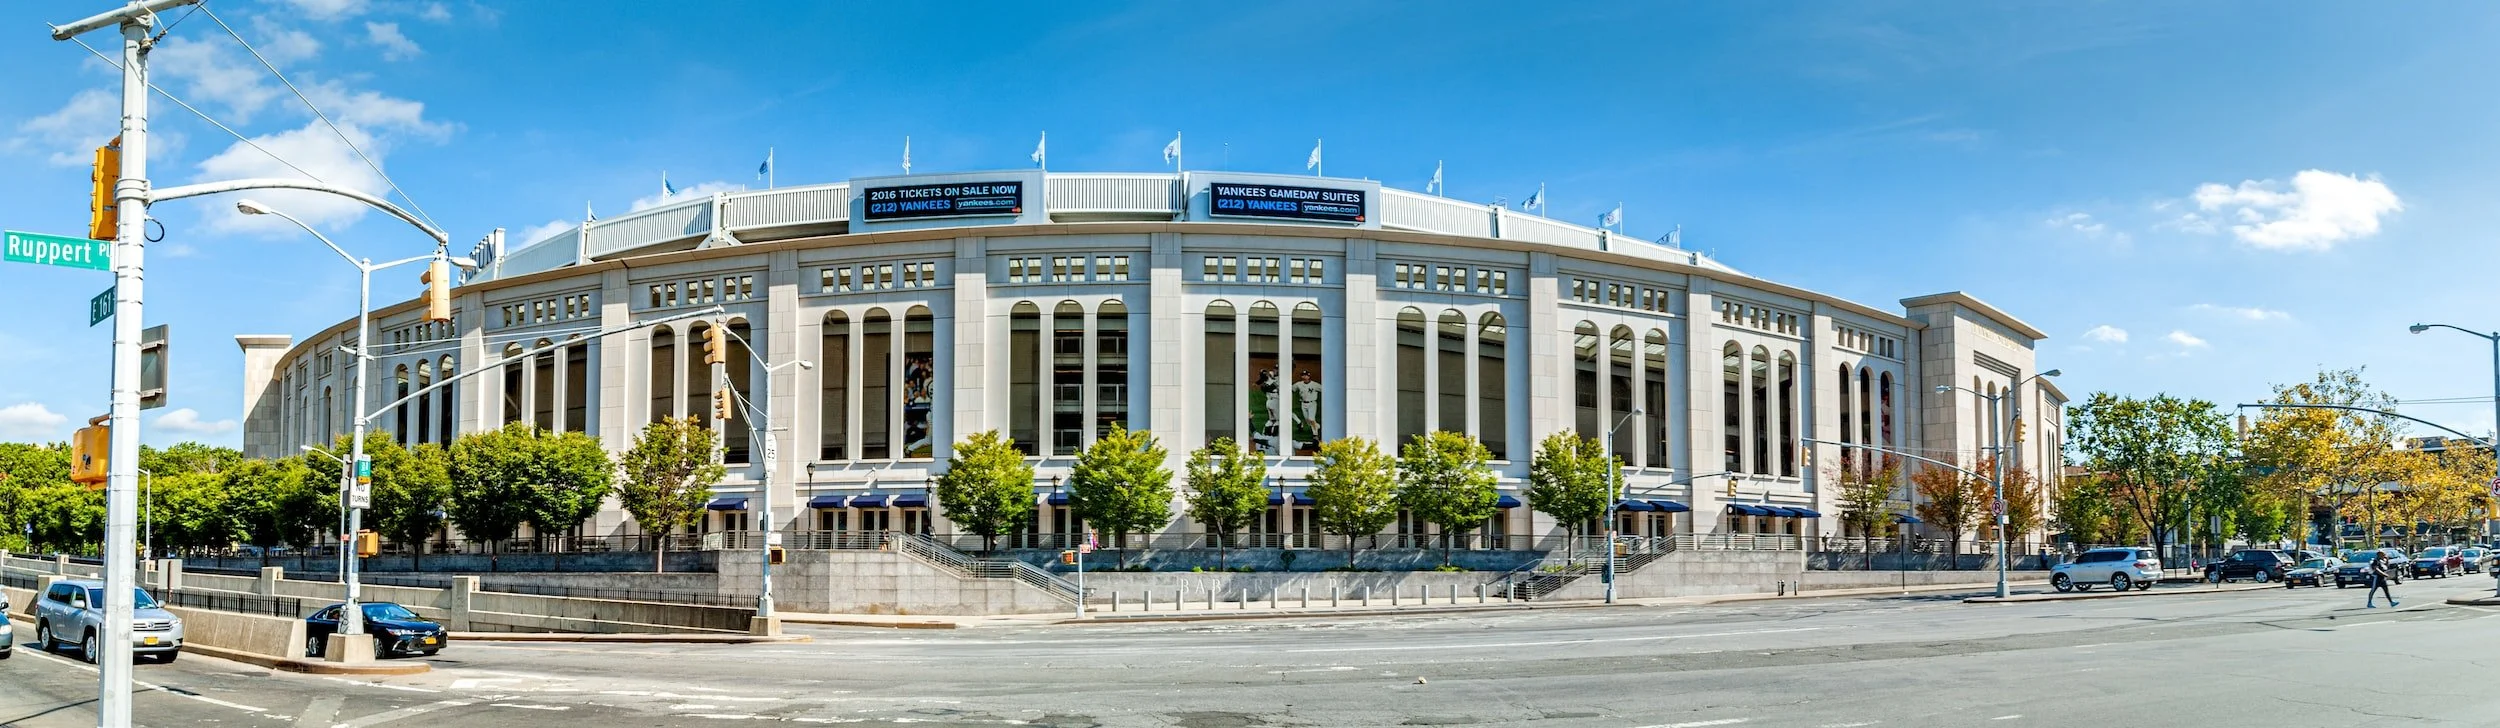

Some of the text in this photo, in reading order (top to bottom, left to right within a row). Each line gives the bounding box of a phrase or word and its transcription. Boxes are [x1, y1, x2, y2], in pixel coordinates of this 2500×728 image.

[871, 185, 1016, 200] 2016 TICKETS ON SALE NOW
[1217, 186, 1360, 203] YANKEES GAMEDAY SUITES
[871, 199, 951, 213] (212) YANKEES
[957, 200, 1014, 208] yankees.com
[1217, 199, 1297, 212] (212) YANKEES
[1303, 204, 1358, 214] yankees.com
[9, 235, 91, 264] Ruppert
[92, 301, 97, 322] E
[99, 292, 111, 318] 161
[352, 495, 368, 503] TURNS
